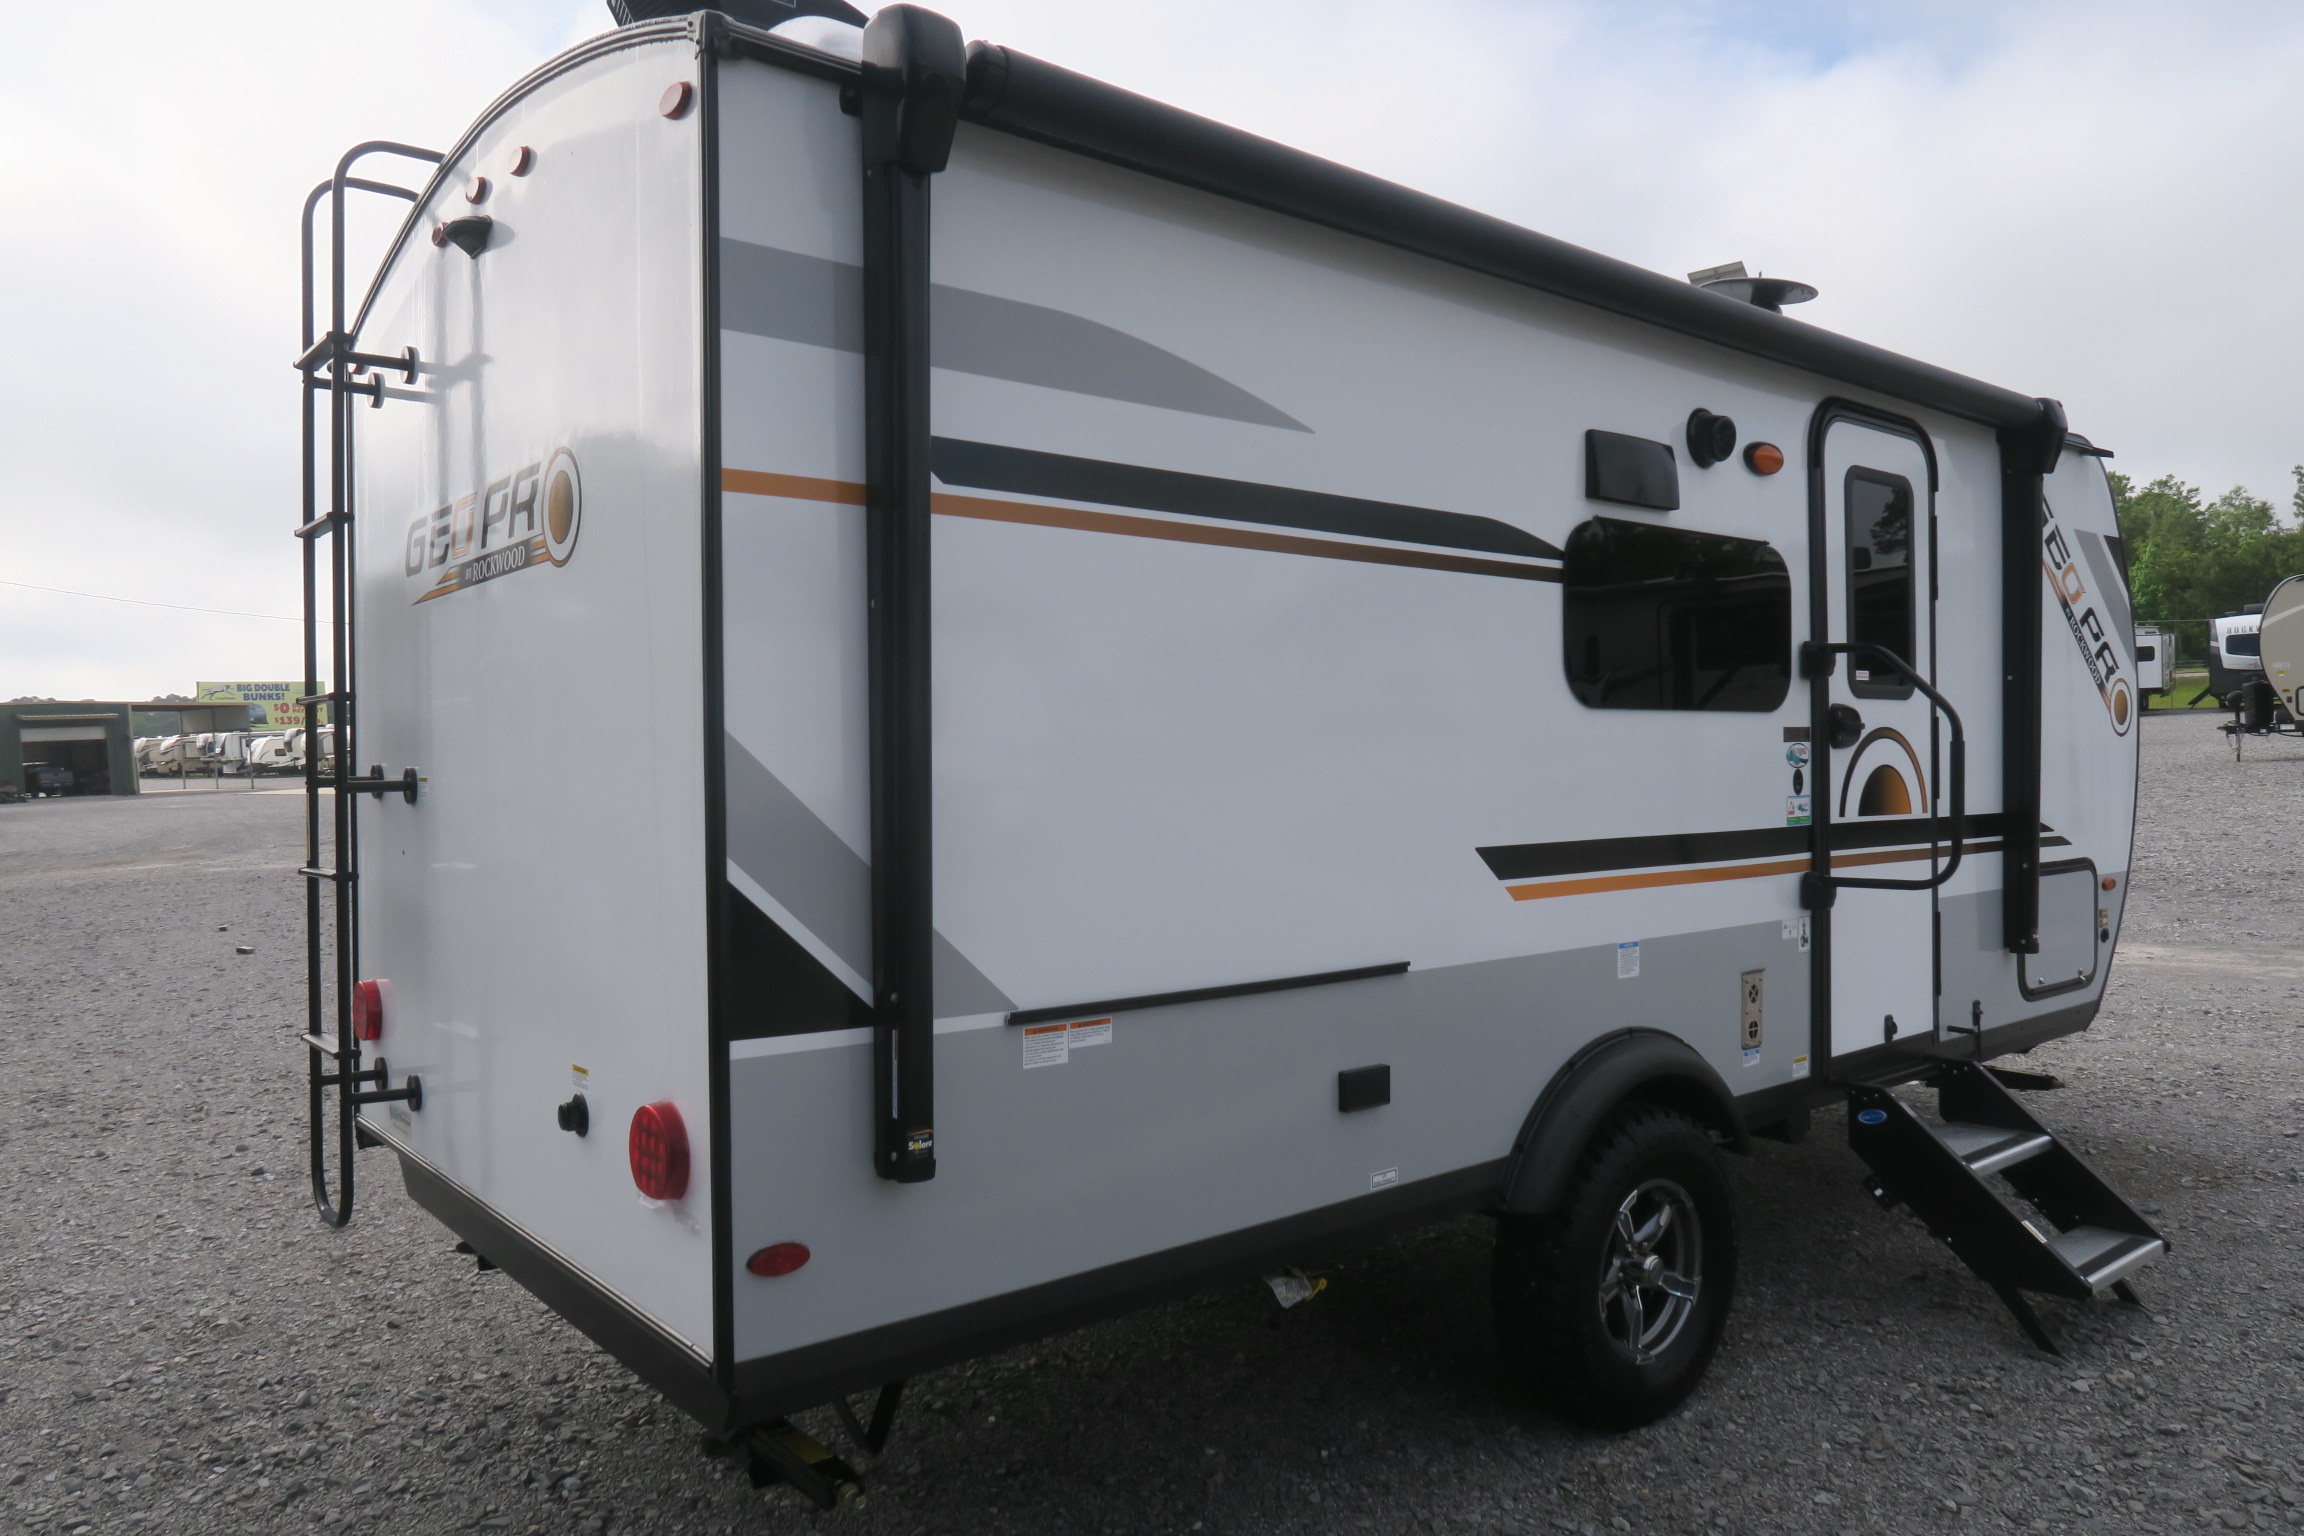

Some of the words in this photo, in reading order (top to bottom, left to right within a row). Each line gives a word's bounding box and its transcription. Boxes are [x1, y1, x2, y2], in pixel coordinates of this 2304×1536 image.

[405, 491, 479, 578] GEO
[481, 447, 583, 569] PRO
[472, 545, 526, 582] ROCKWOOD
[2043, 494, 2087, 604] EO
[2079, 606, 2133, 738] PRO
[2069, 616, 2101, 685] ROCKWOOD
[236, 683, 253, 692] BIG
[254, 683, 290, 692] DOUBLE
[243, 692, 285, 701] BUNKS!
[273, 702, 290, 714] $0
